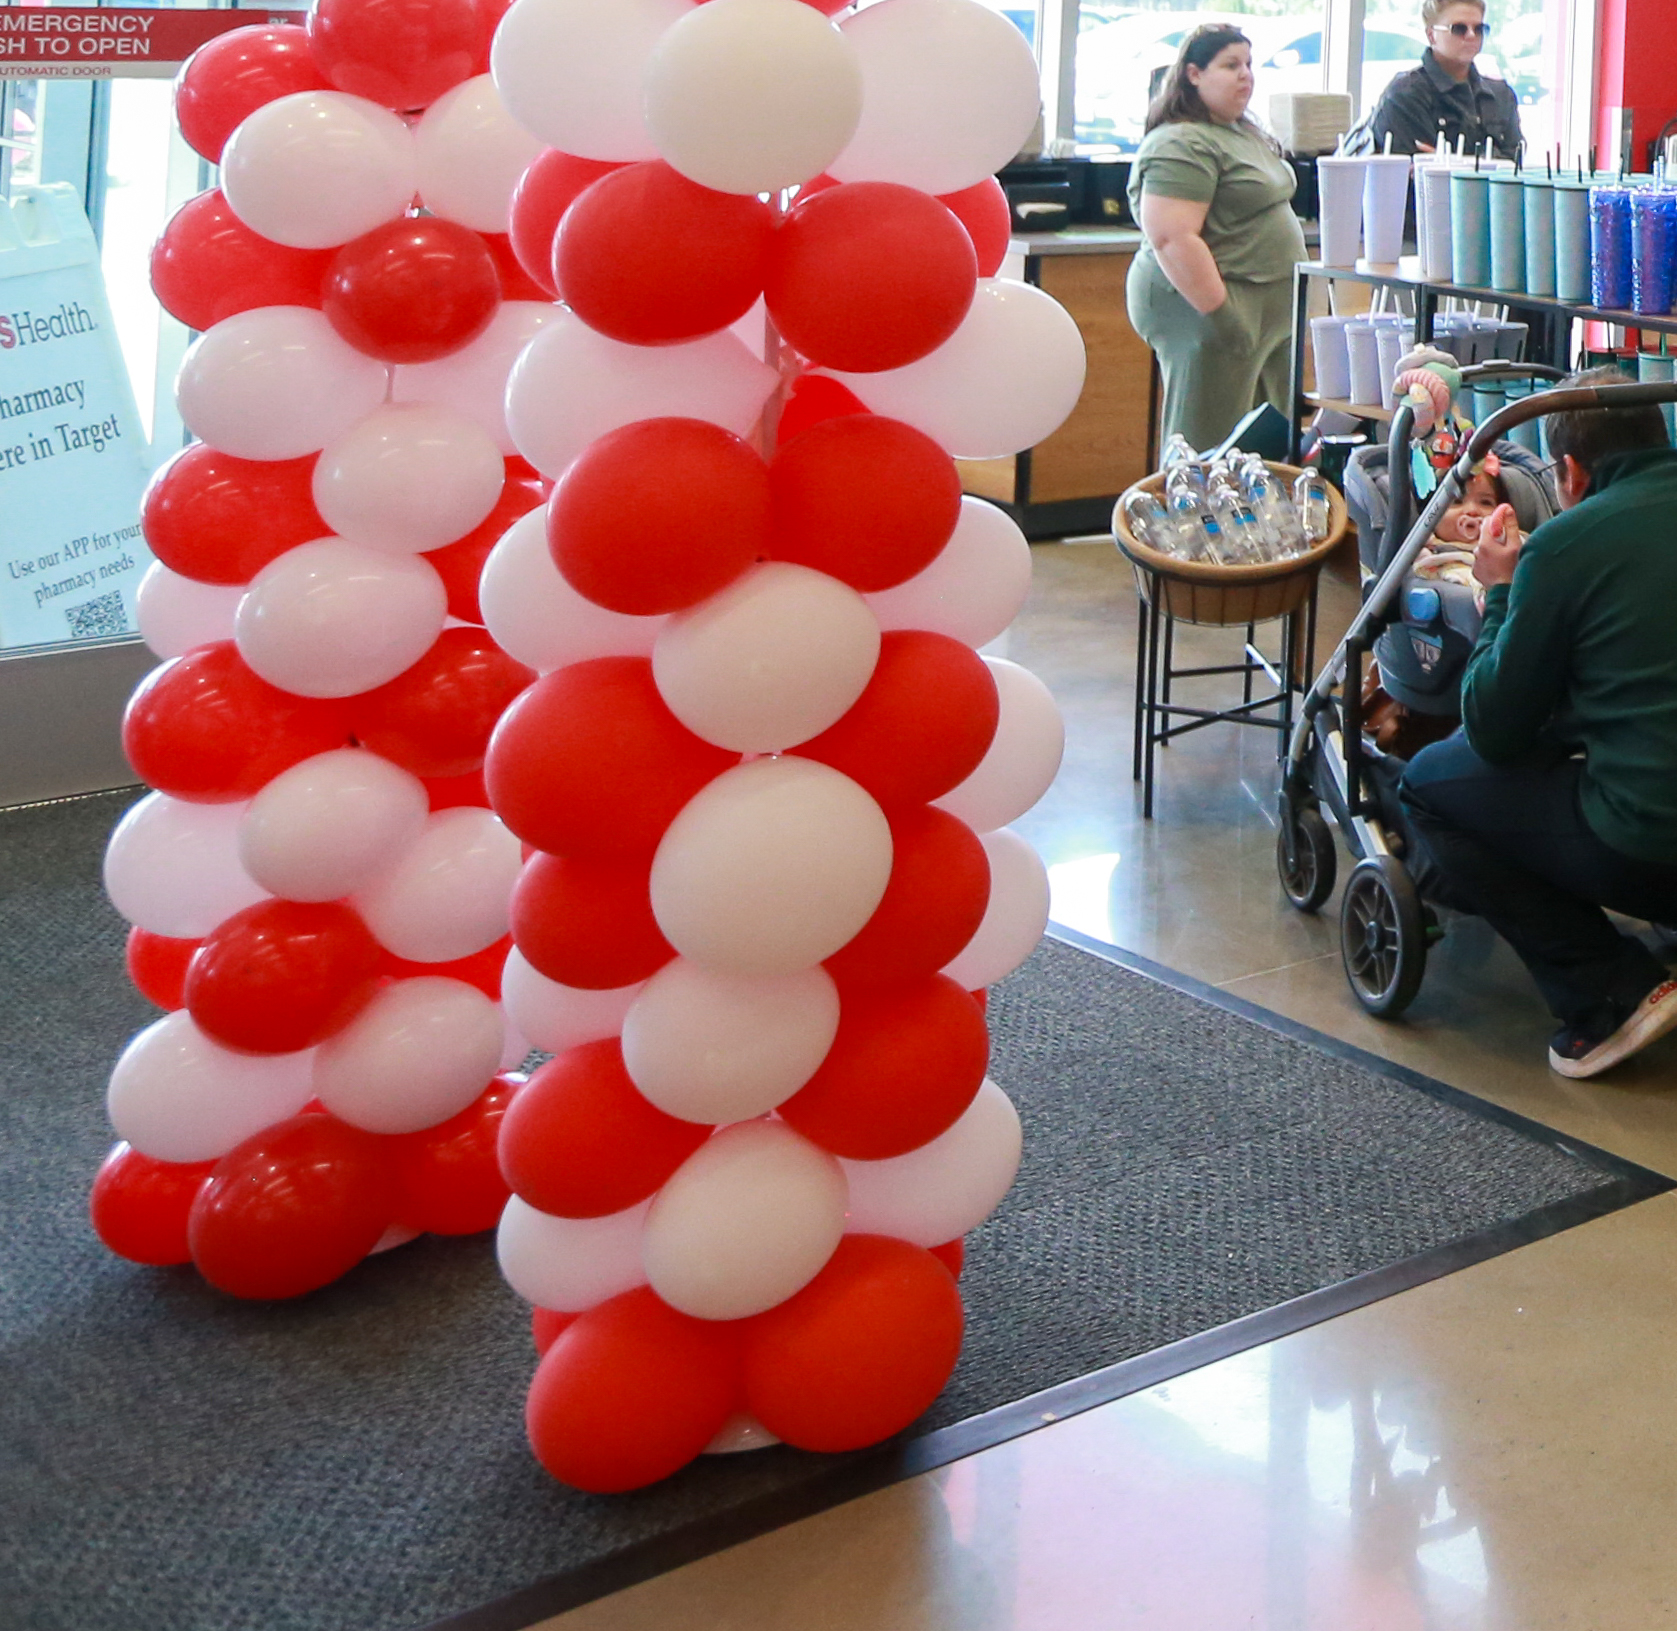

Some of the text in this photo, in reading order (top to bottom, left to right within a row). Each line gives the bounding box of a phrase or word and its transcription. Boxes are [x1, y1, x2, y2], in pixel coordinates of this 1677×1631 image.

[0, 14, 154, 34] MERGENCY
[35, 37, 70, 55] TO
[78, 37, 150, 55] OPEN
[73, 66, 111, 76] DOOR
[28, 432, 55, 460] in
[55, 414, 122, 453] Target
[9, 559, 37, 580] Use
[38, 549, 61, 570] our
[63, 536, 90, 563] APP
[92, 530, 112, 552] for
[34, 554, 136, 609] pharmacy needs
